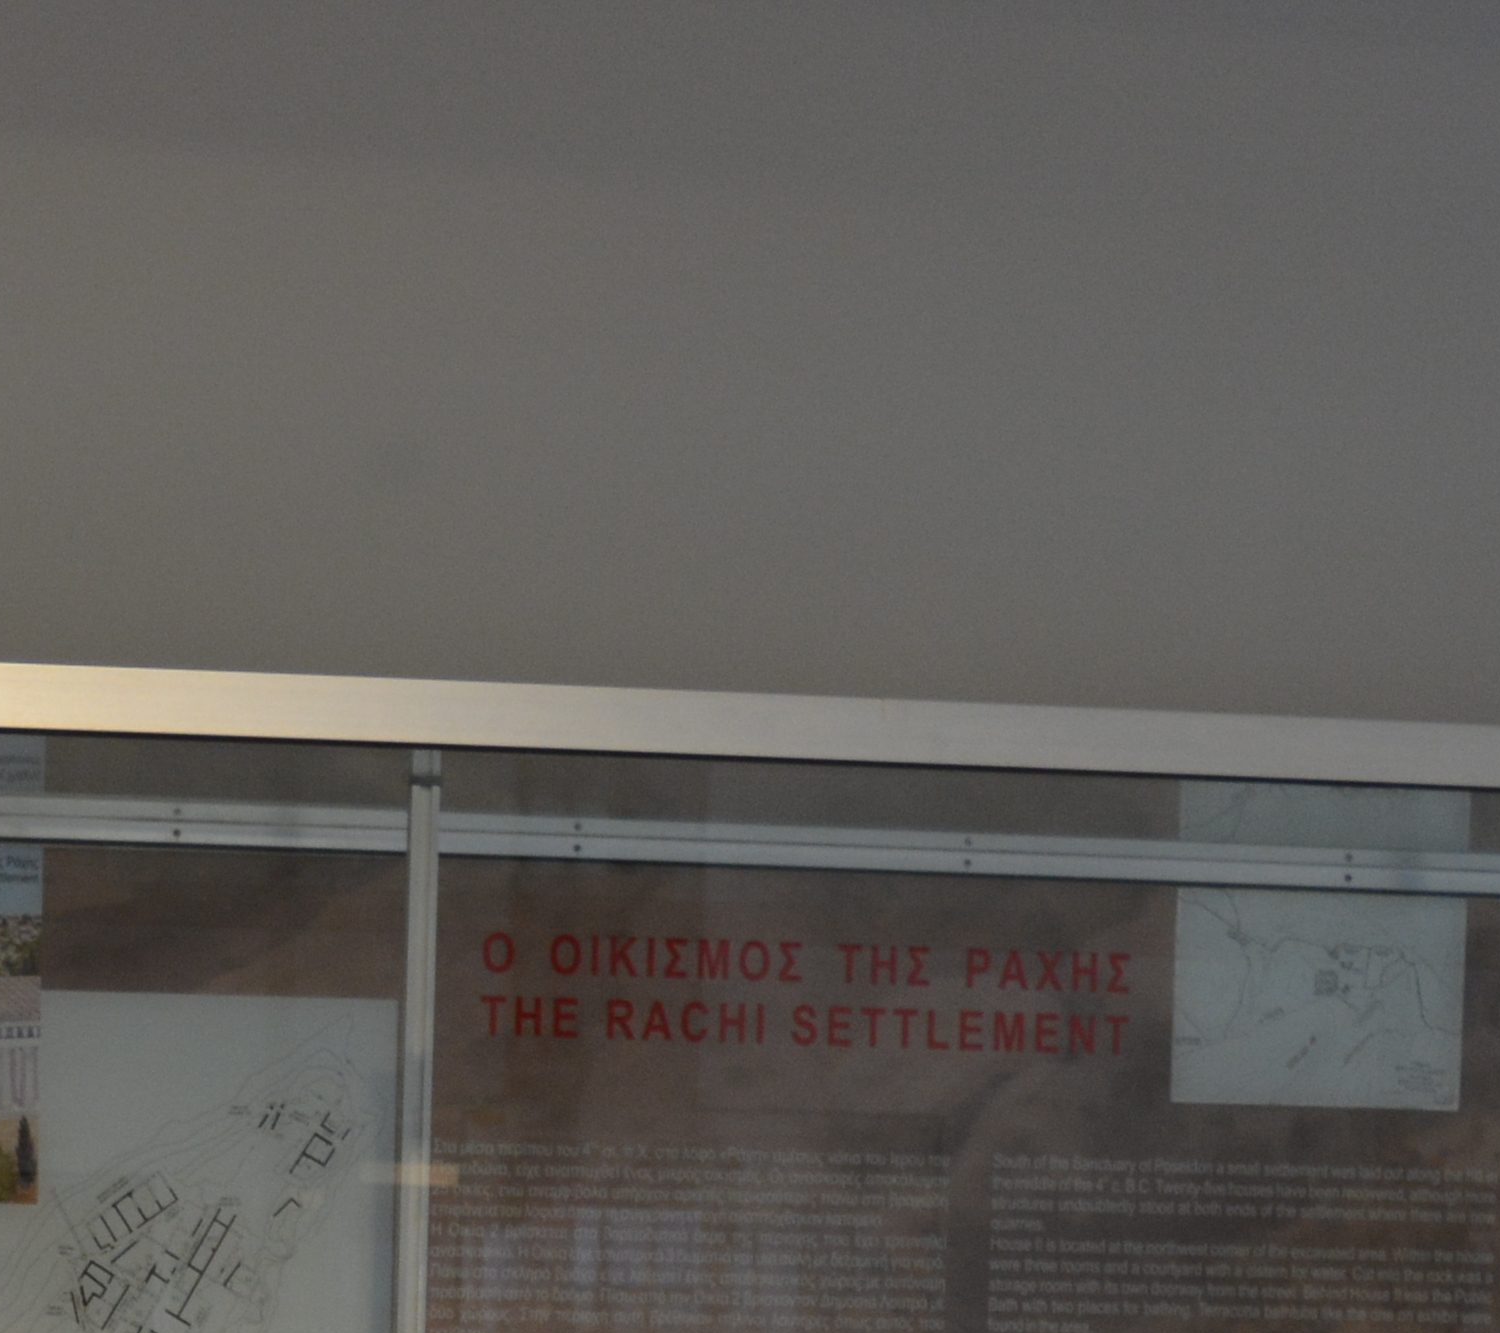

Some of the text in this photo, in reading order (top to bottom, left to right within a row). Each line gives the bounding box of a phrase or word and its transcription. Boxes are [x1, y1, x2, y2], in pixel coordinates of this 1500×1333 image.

[481, 930, 1130, 994] Ο ΟΙΚΙΣΜΟΣ ΤΗΣ ΡΑΧΗΣ
[481, 996, 1130, 1055] THE RACHI SETTLEMENT
